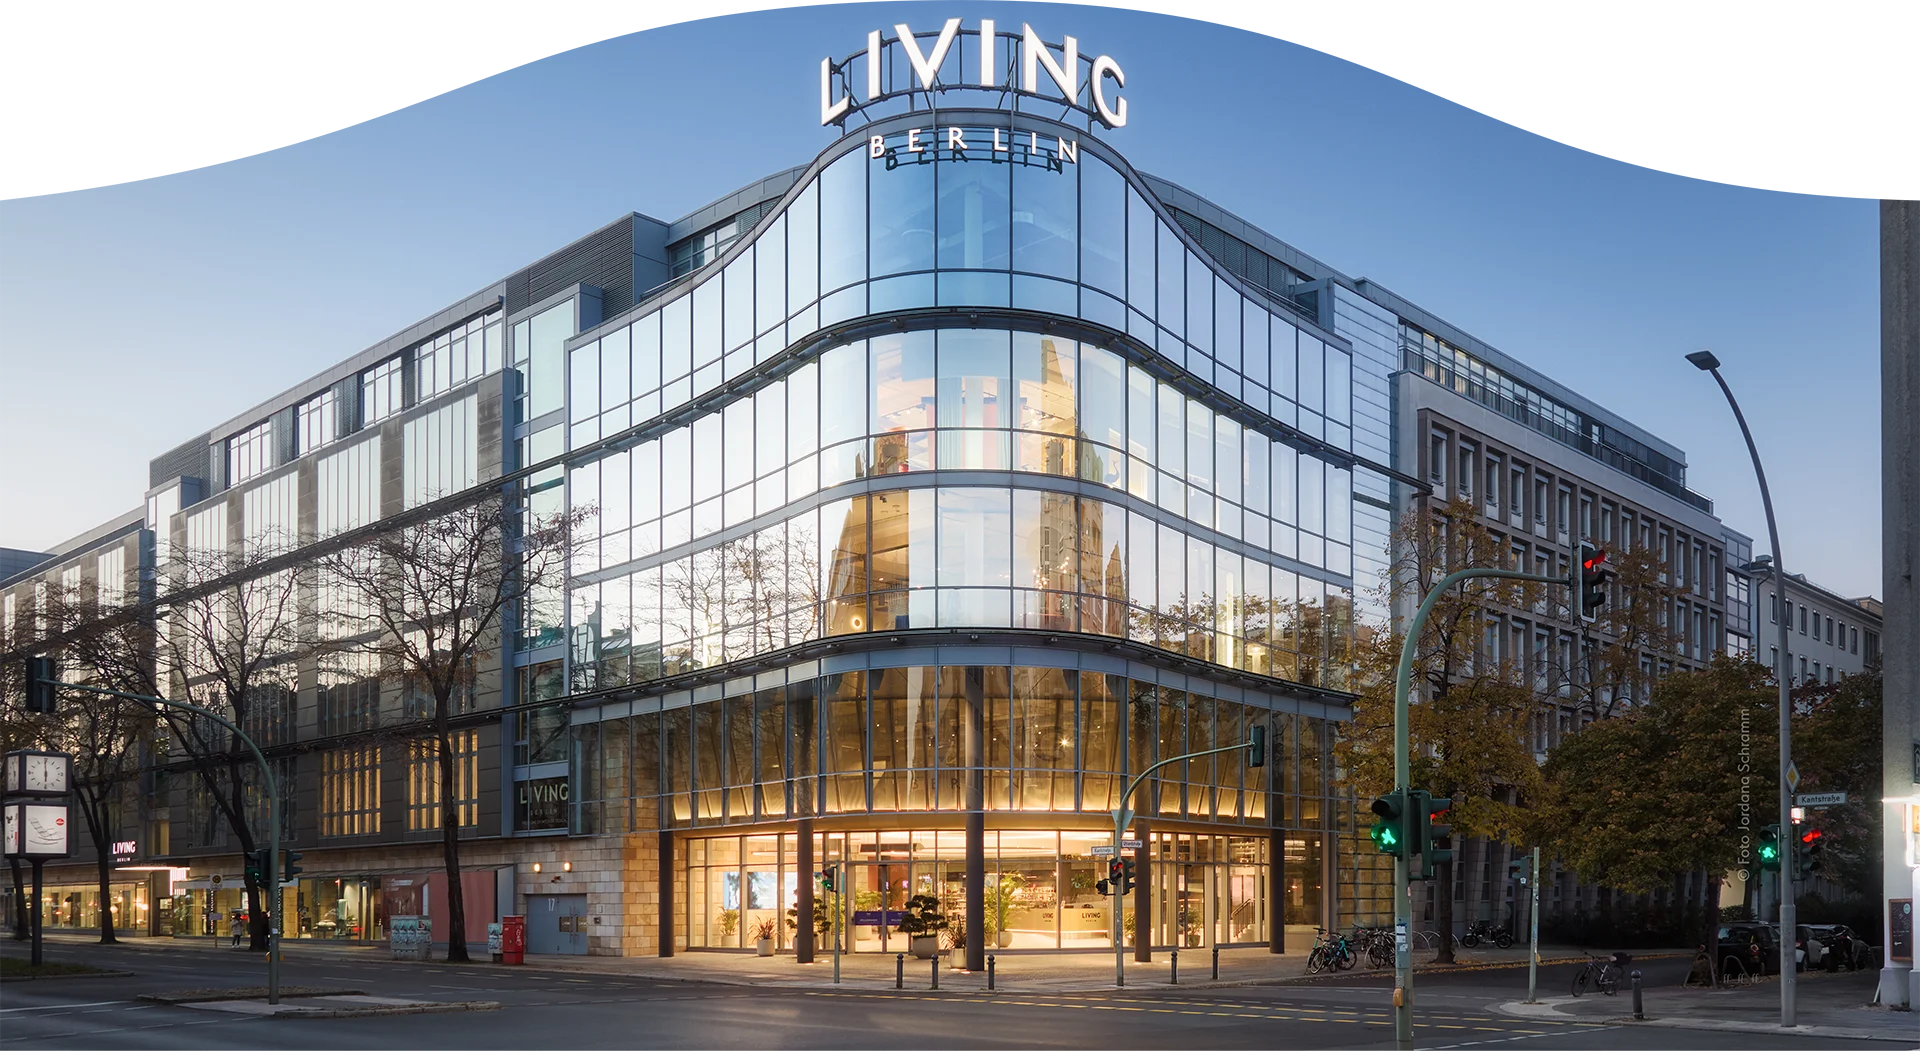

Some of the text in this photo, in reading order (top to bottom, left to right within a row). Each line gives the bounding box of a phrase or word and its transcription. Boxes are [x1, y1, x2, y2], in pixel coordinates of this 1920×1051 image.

[821, 18, 1127, 128] LIVING
[870, 127, 1077, 164] BERLIN
[520, 783, 569, 804] LIVING
[1801, 794, 1841, 803] Kantstraße
[112, 840, 136, 854] LIVING
[548, 898, 556, 911] 17
